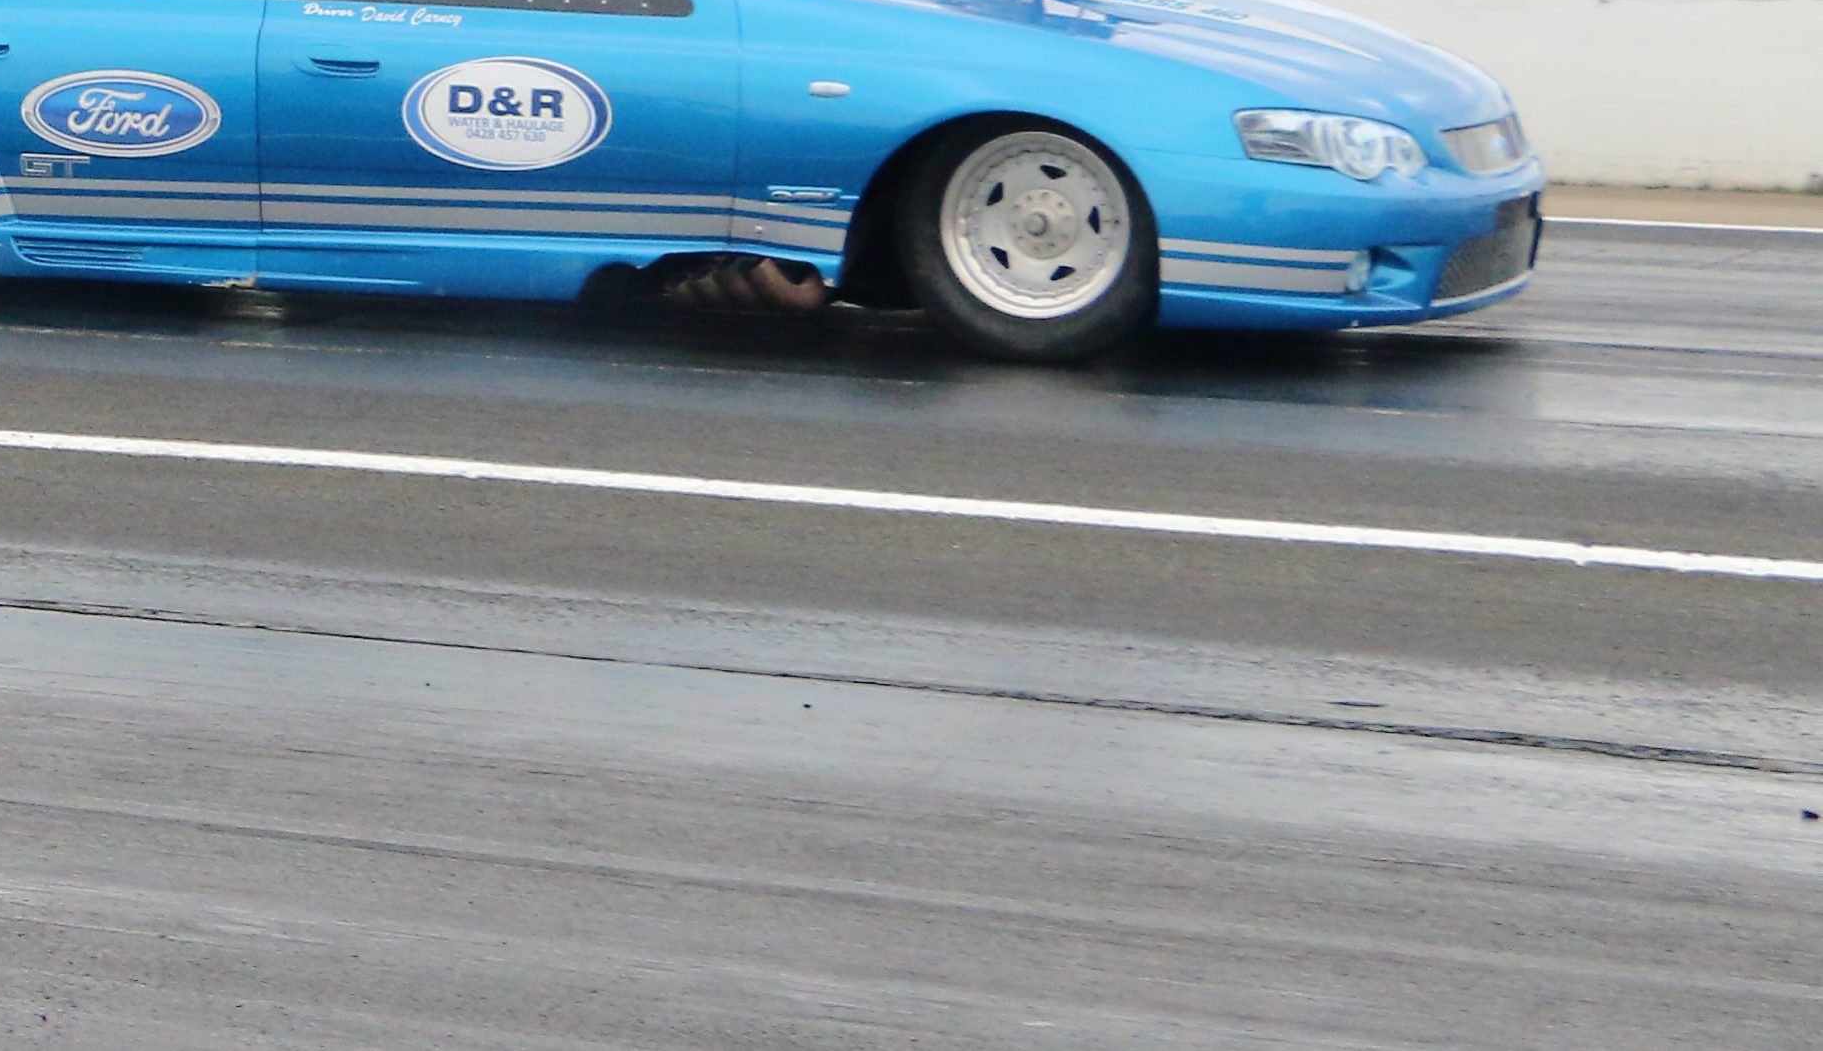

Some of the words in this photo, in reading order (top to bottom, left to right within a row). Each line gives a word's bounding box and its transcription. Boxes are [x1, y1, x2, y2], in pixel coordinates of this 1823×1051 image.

[303, 2, 354, 17] Driver
[361, 6, 406, 22] David
[67, 87, 172, 137] Ford
[448, 84, 565, 119] D&R
[448, 117, 490, 128] WATER
[493, 118, 503, 129] &
[507, 119, 565, 133] HAULAGE
[498, 130, 519, 141] 457
[21, 153, 90, 178] GT
